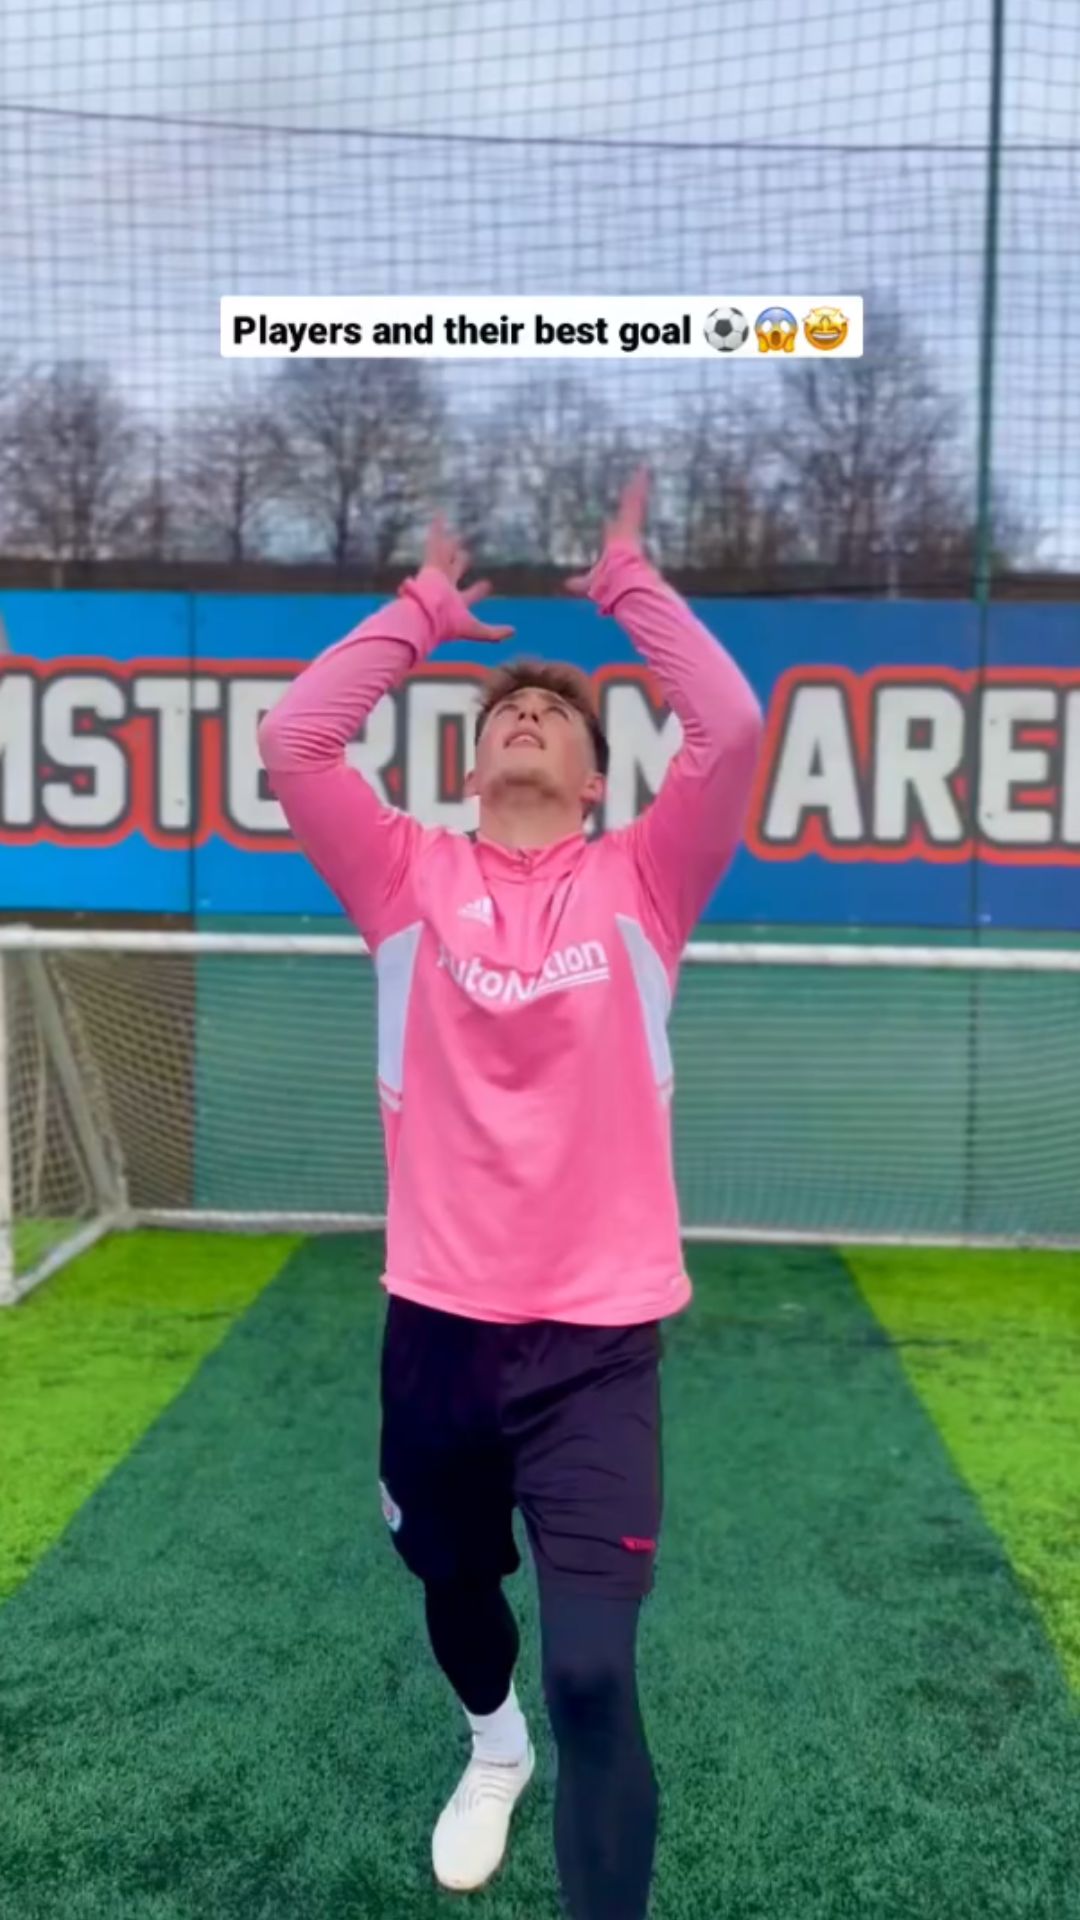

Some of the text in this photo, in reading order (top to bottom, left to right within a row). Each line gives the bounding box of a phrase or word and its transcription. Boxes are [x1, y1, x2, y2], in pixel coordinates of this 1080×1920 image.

[0, 673, 1080, 844] STEDM ARE
[436, 940, 607, 1004] utoNion
